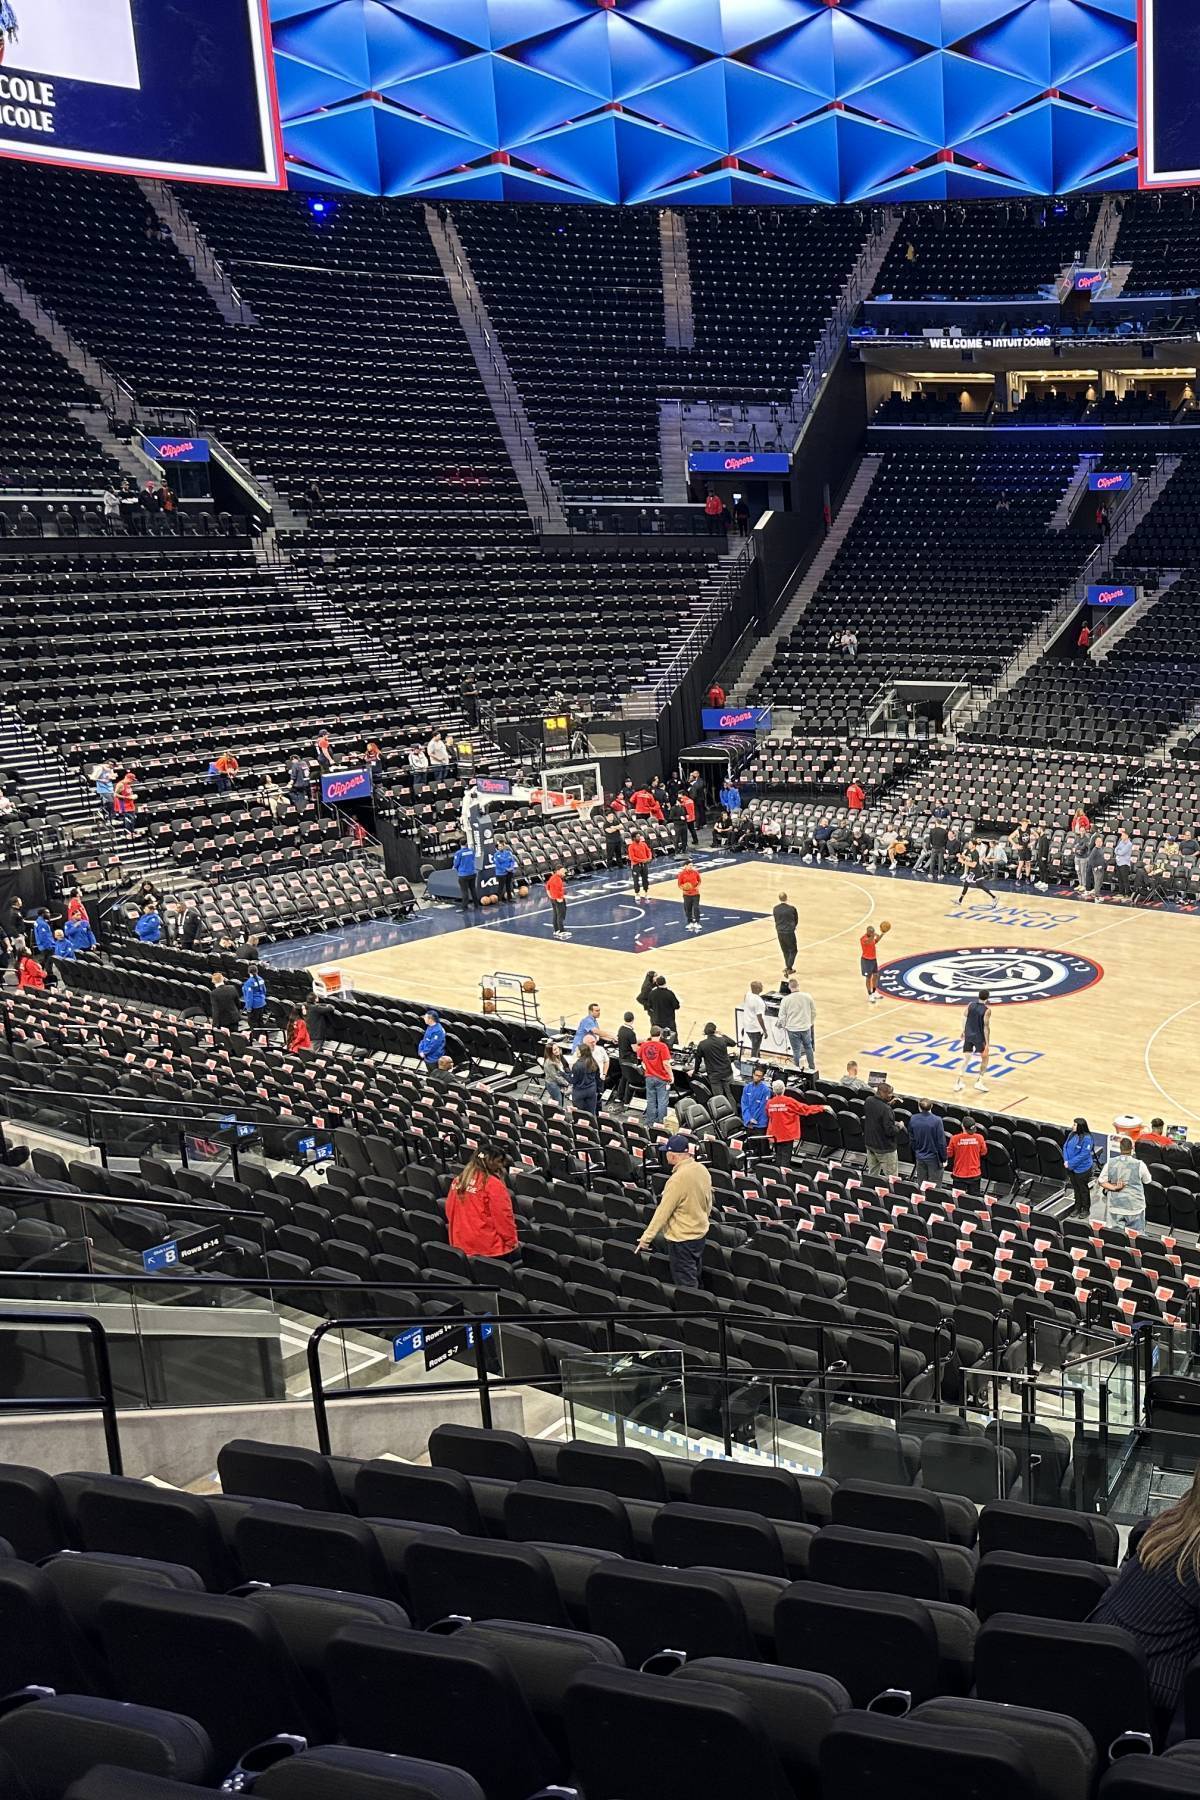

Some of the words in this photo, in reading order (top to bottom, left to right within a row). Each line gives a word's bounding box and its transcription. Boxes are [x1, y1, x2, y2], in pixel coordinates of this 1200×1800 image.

[929, 338, 983, 349] WELCOME
[993, 338, 1022, 348] INTUIT
[720, 712, 752, 727] Clippers
[327, 775, 366, 798] Clippers
[944, 911, 1058, 930] INTUIT
[181, 1245, 202, 1258] Rows
[203, 1238, 220, 1249] 8-14
[164, 1250, 176, 1263] 8
[412, 1334, 422, 1349] 8
[424, 1329, 444, 1342] Rows
[428, 1351, 448, 1368] Rows
[447, 1345, 459, 1357] 3-7
